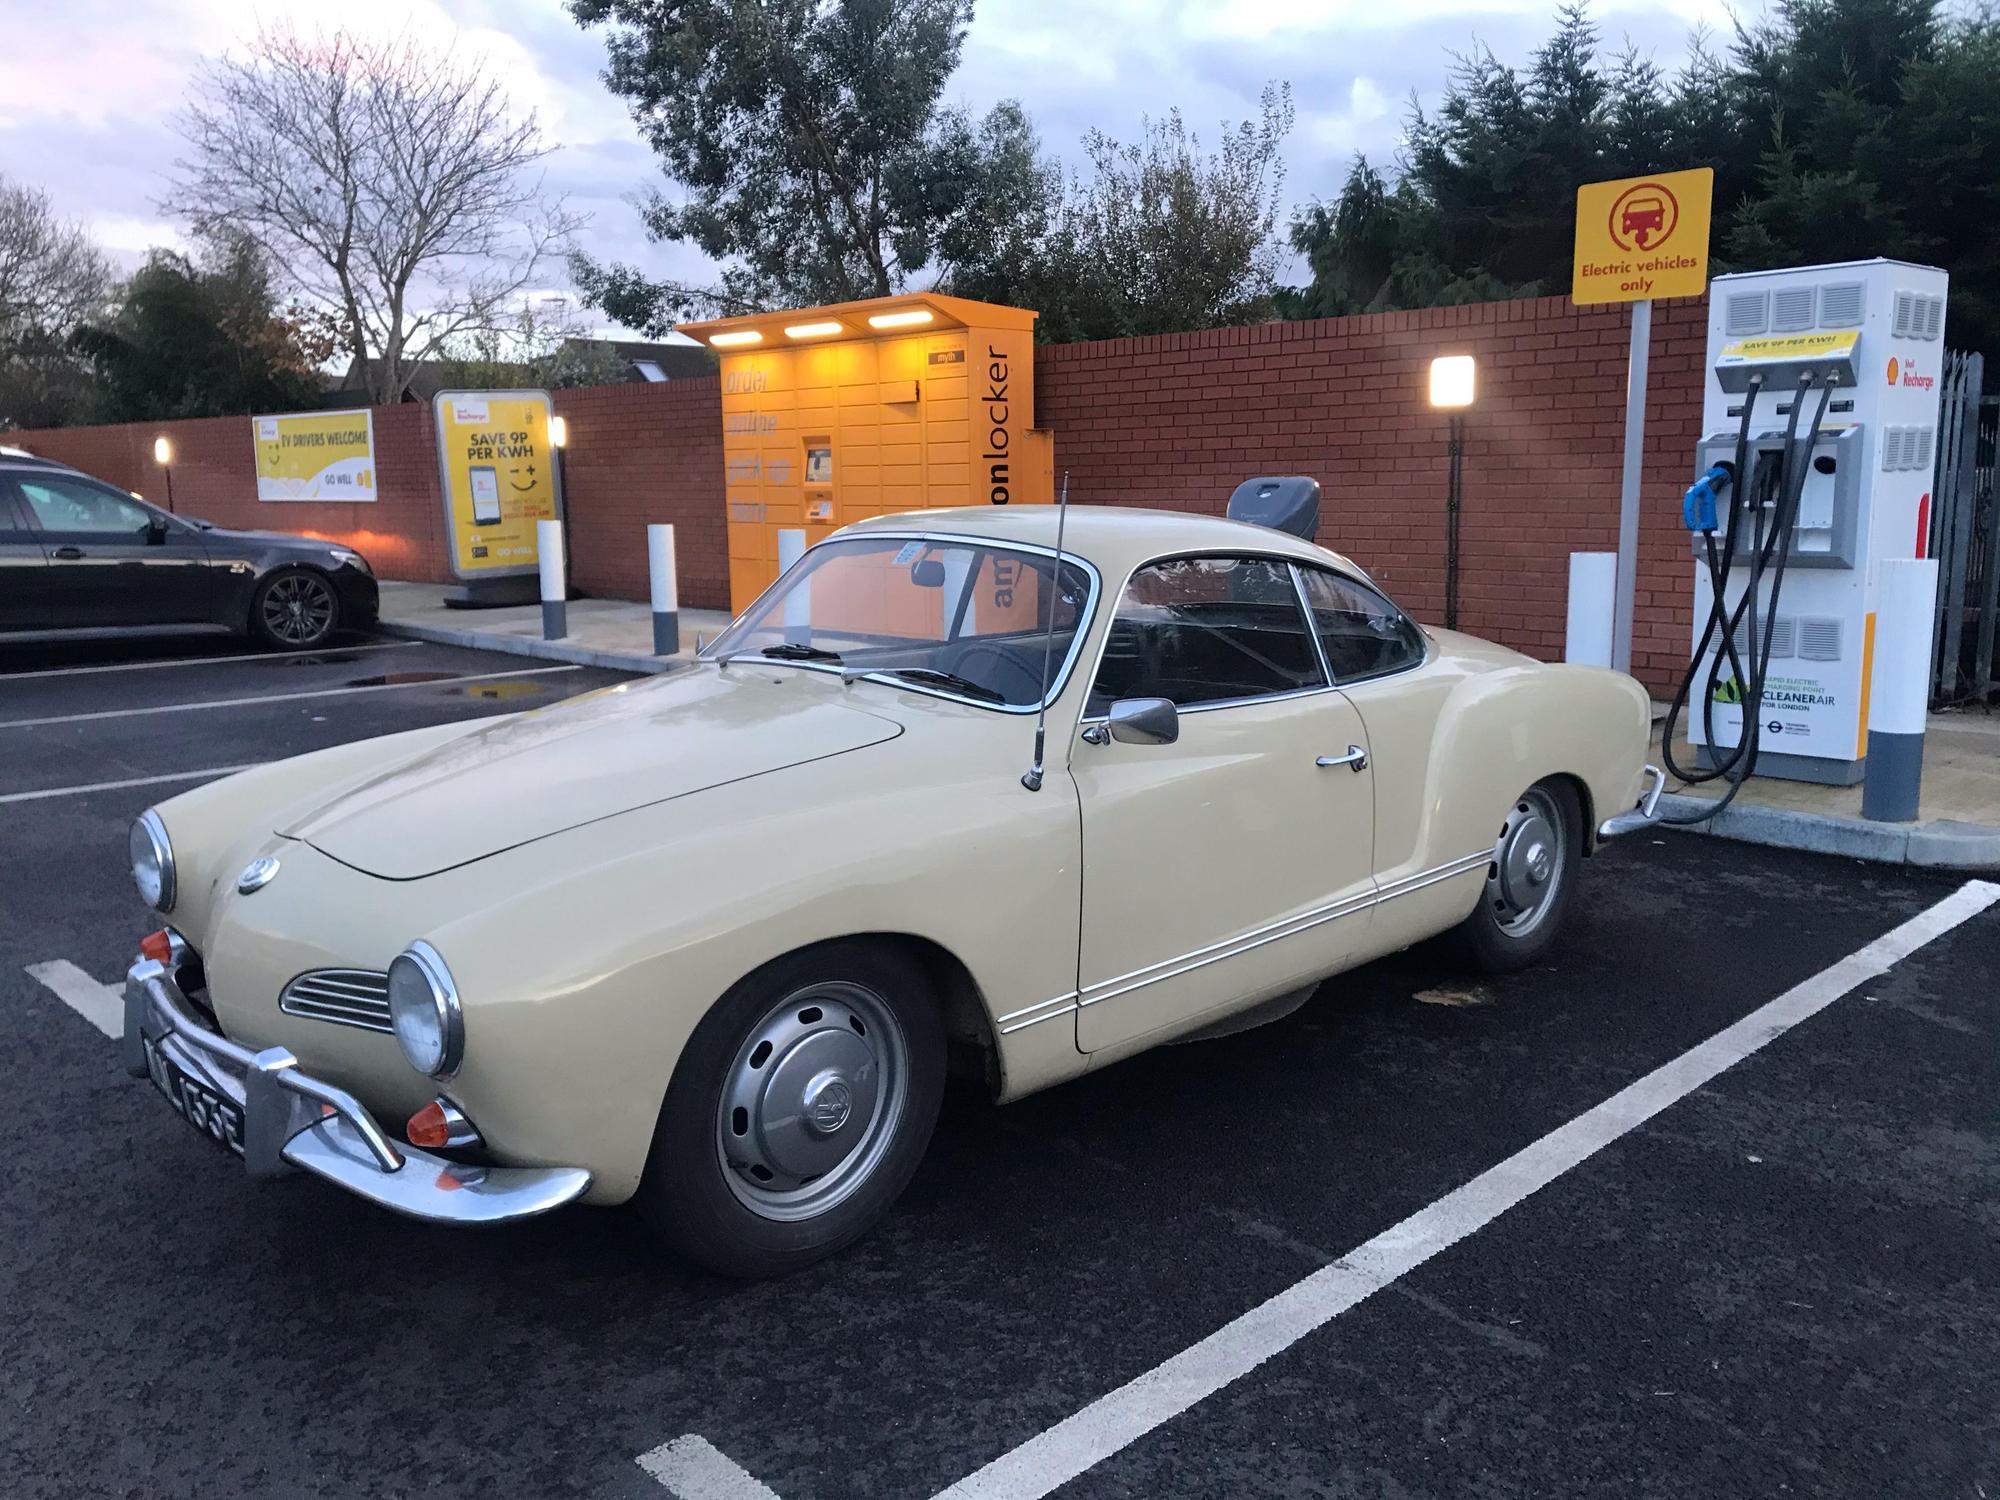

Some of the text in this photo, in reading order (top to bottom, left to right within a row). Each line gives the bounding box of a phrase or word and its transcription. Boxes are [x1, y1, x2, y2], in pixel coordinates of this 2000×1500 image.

[1582, 255, 1697, 277] Electric vehicles
[1620, 277, 1654, 293] only
[1743, 341, 1768, 350] SAVE
[1786, 338, 1806, 346] PER
[1807, 336, 1836, 344] KWH
[727, 364, 769, 393] order
[1903, 370, 1934, 391] Recharge
[294, 432, 325, 447] DRIVERS
[327, 430, 367, 446] WELCOME
[470, 431, 528, 446] SAVE 9P
[467, 444, 534, 460] PER KWH
[324, 473, 336, 485] GO
[1761, 701, 1810, 712] FOR LONDON
